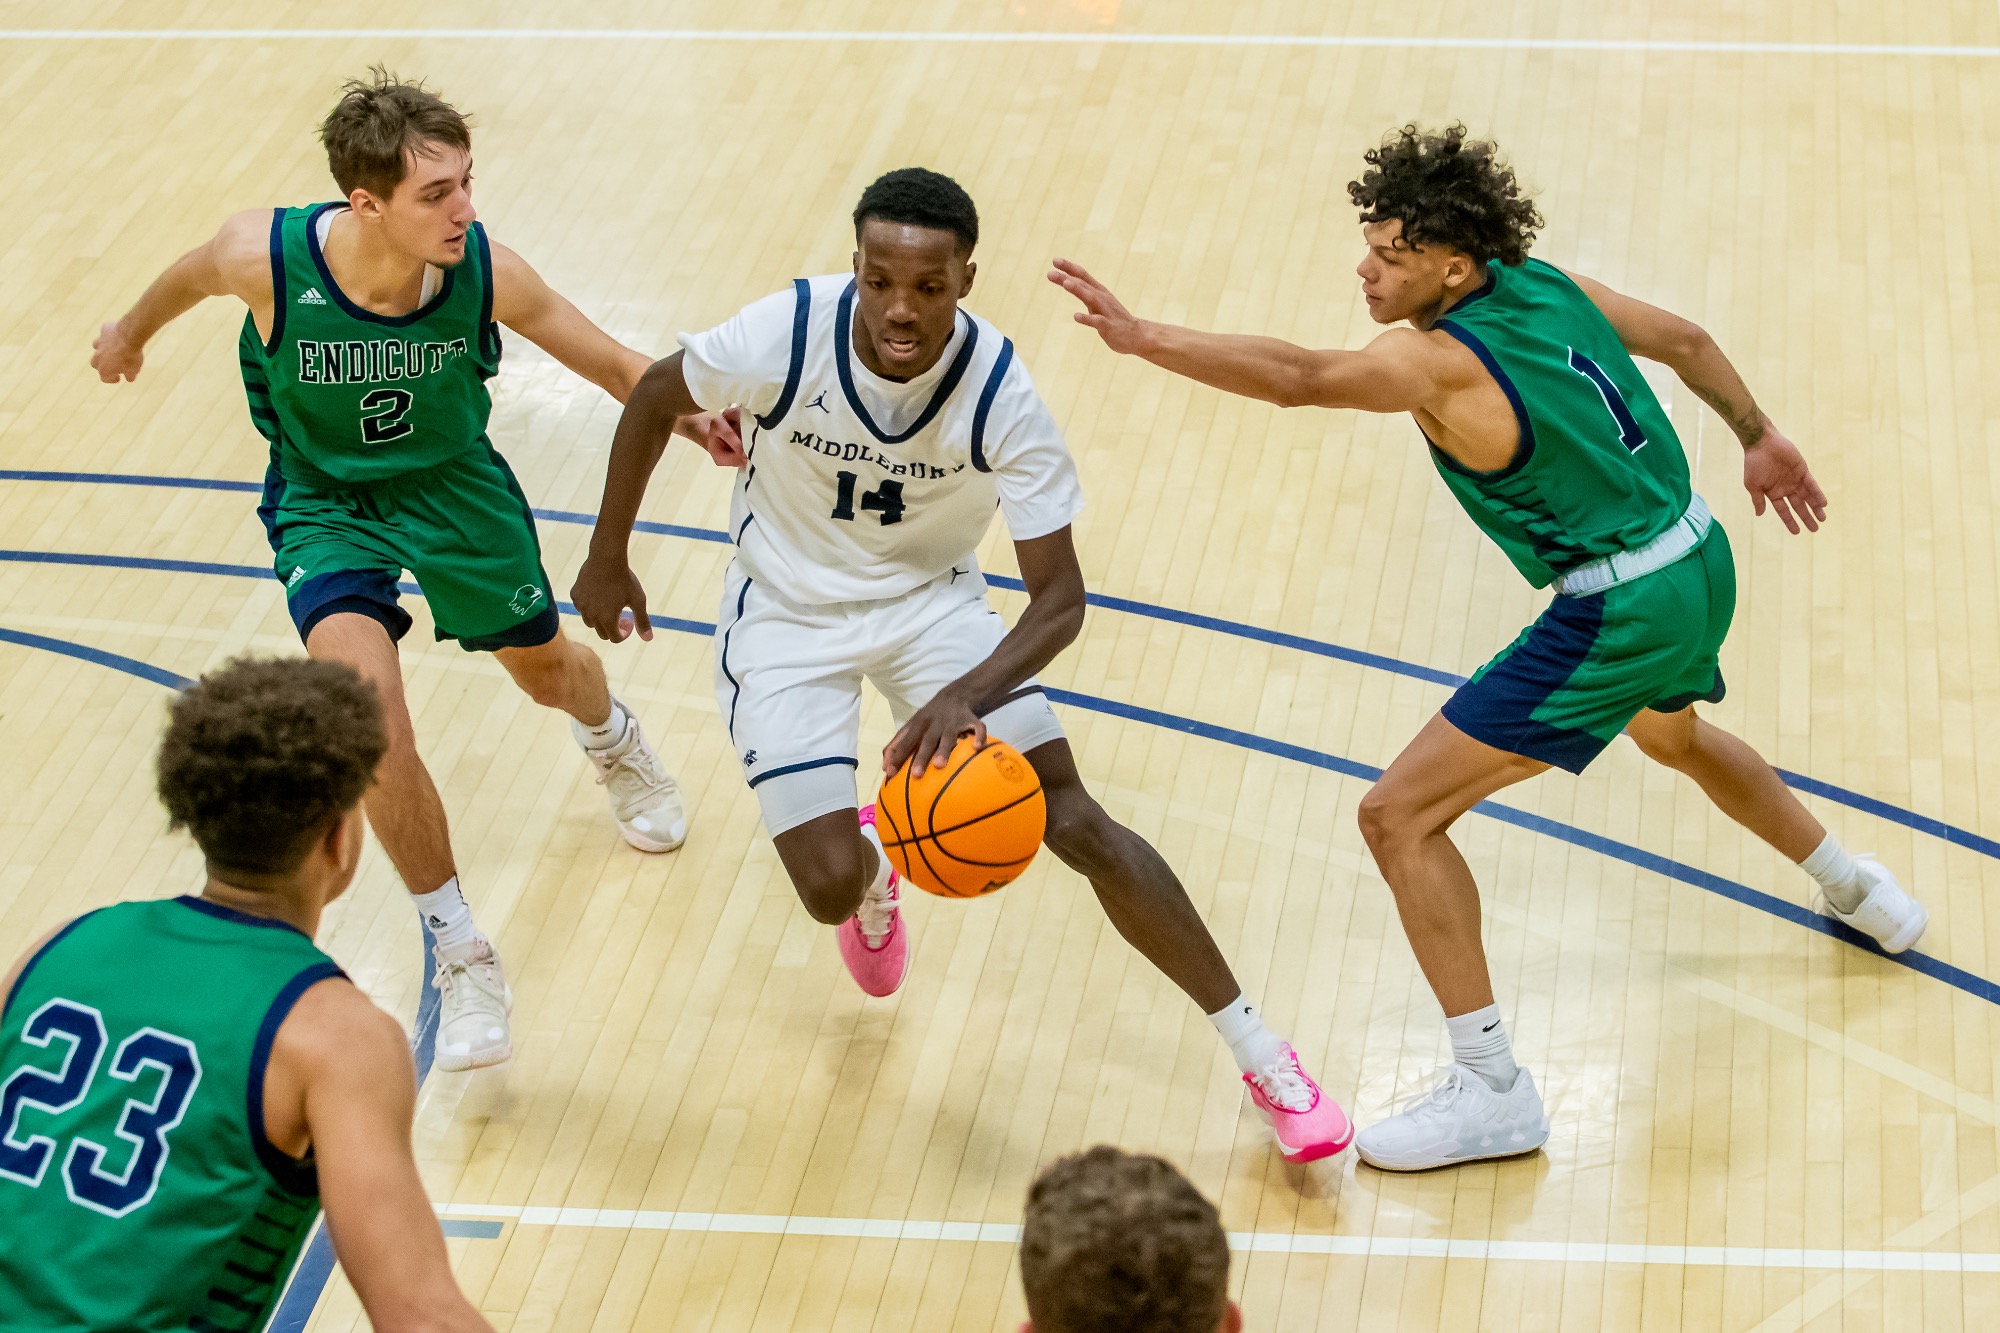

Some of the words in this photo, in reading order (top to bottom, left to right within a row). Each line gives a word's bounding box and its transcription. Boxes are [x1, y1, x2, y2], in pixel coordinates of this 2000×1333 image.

[298, 297, 327, 306] adidas
[360, 388, 414, 444] 2
[1567, 345, 1649, 456] 1
[831, 470, 907, 526] 14
[0, 997, 203, 1219] 23
